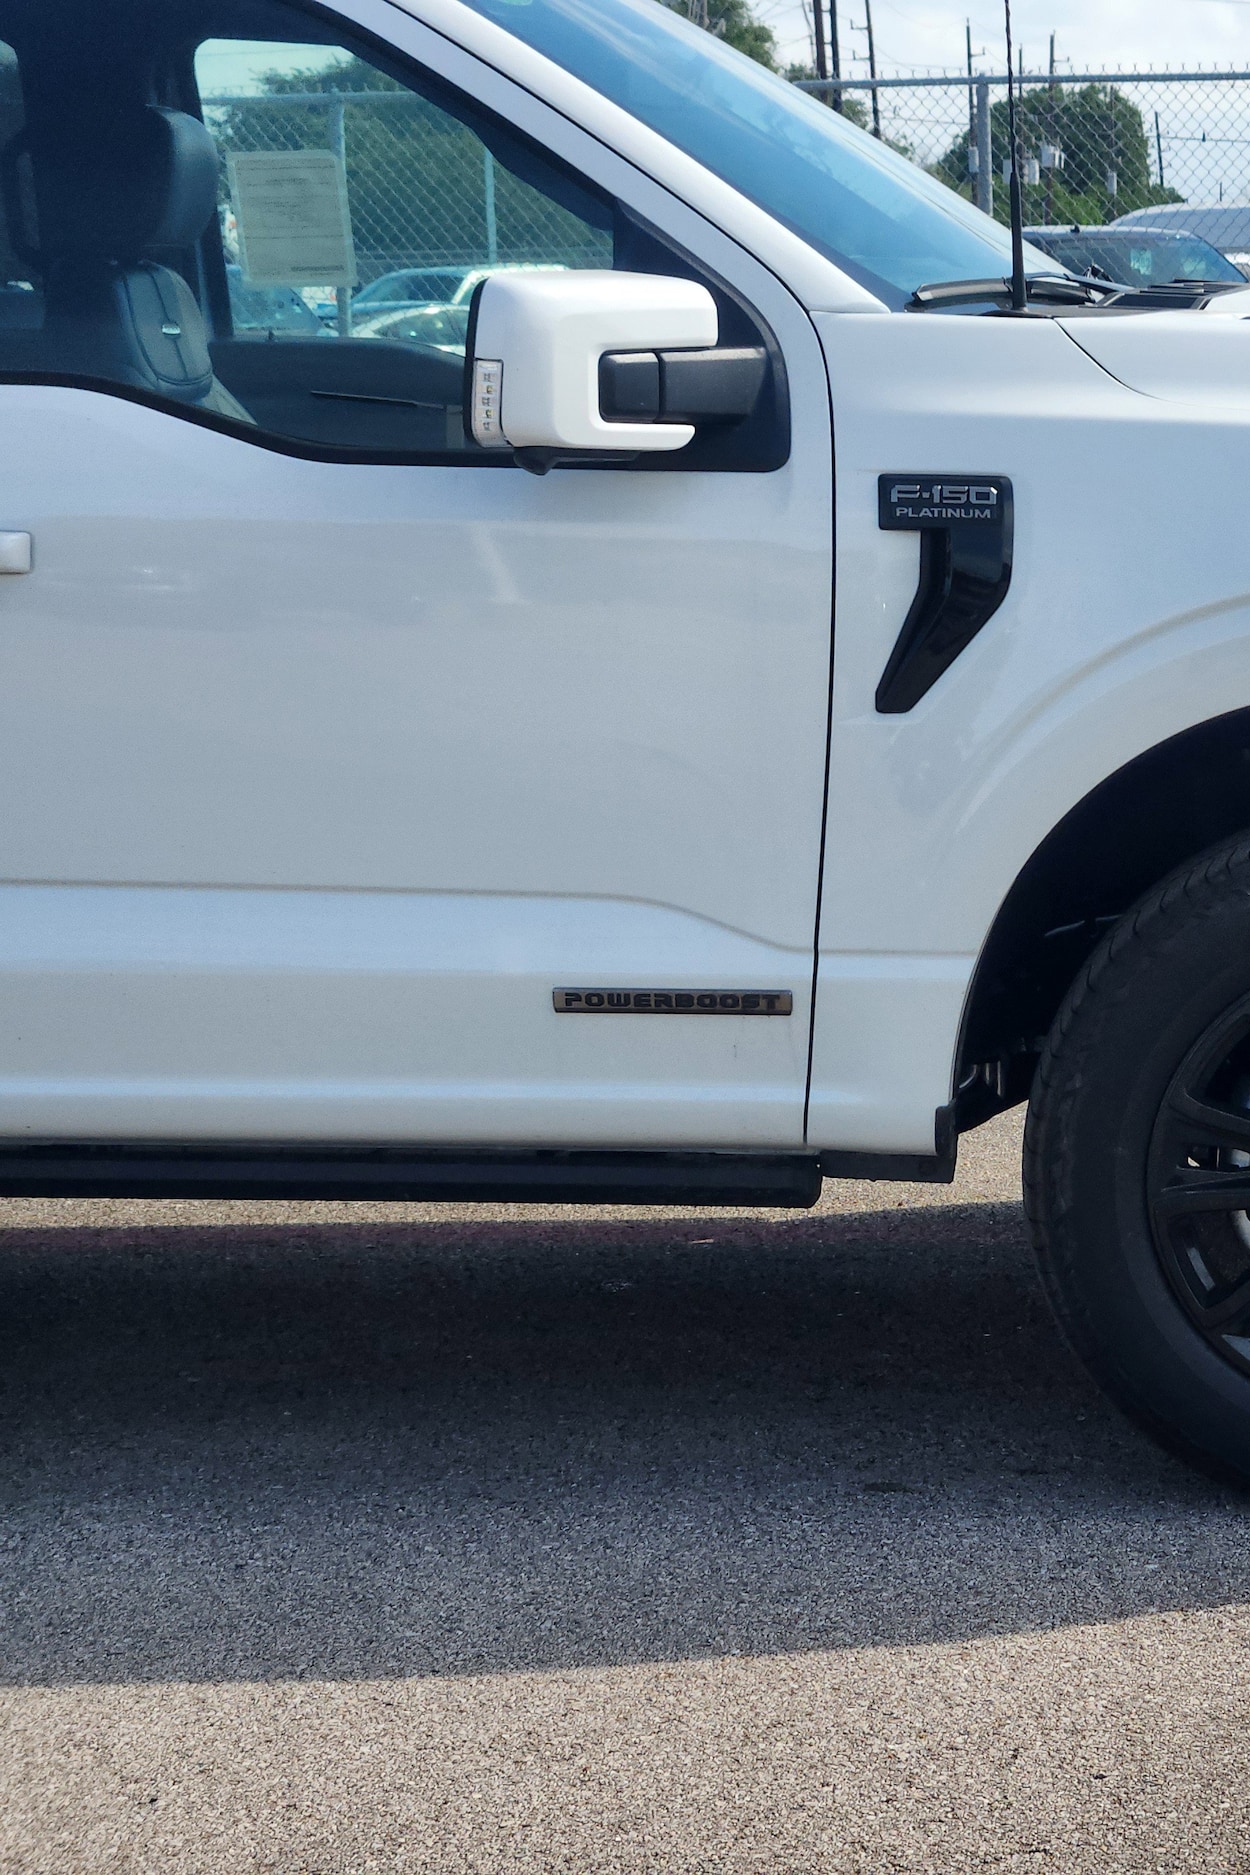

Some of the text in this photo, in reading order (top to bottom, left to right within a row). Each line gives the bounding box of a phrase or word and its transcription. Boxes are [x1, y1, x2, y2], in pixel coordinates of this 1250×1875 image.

[890, 484, 998, 505] F-150
[895, 507, 991, 519] PLATINUM
[564, 992, 781, 1010] POWERBOOST
